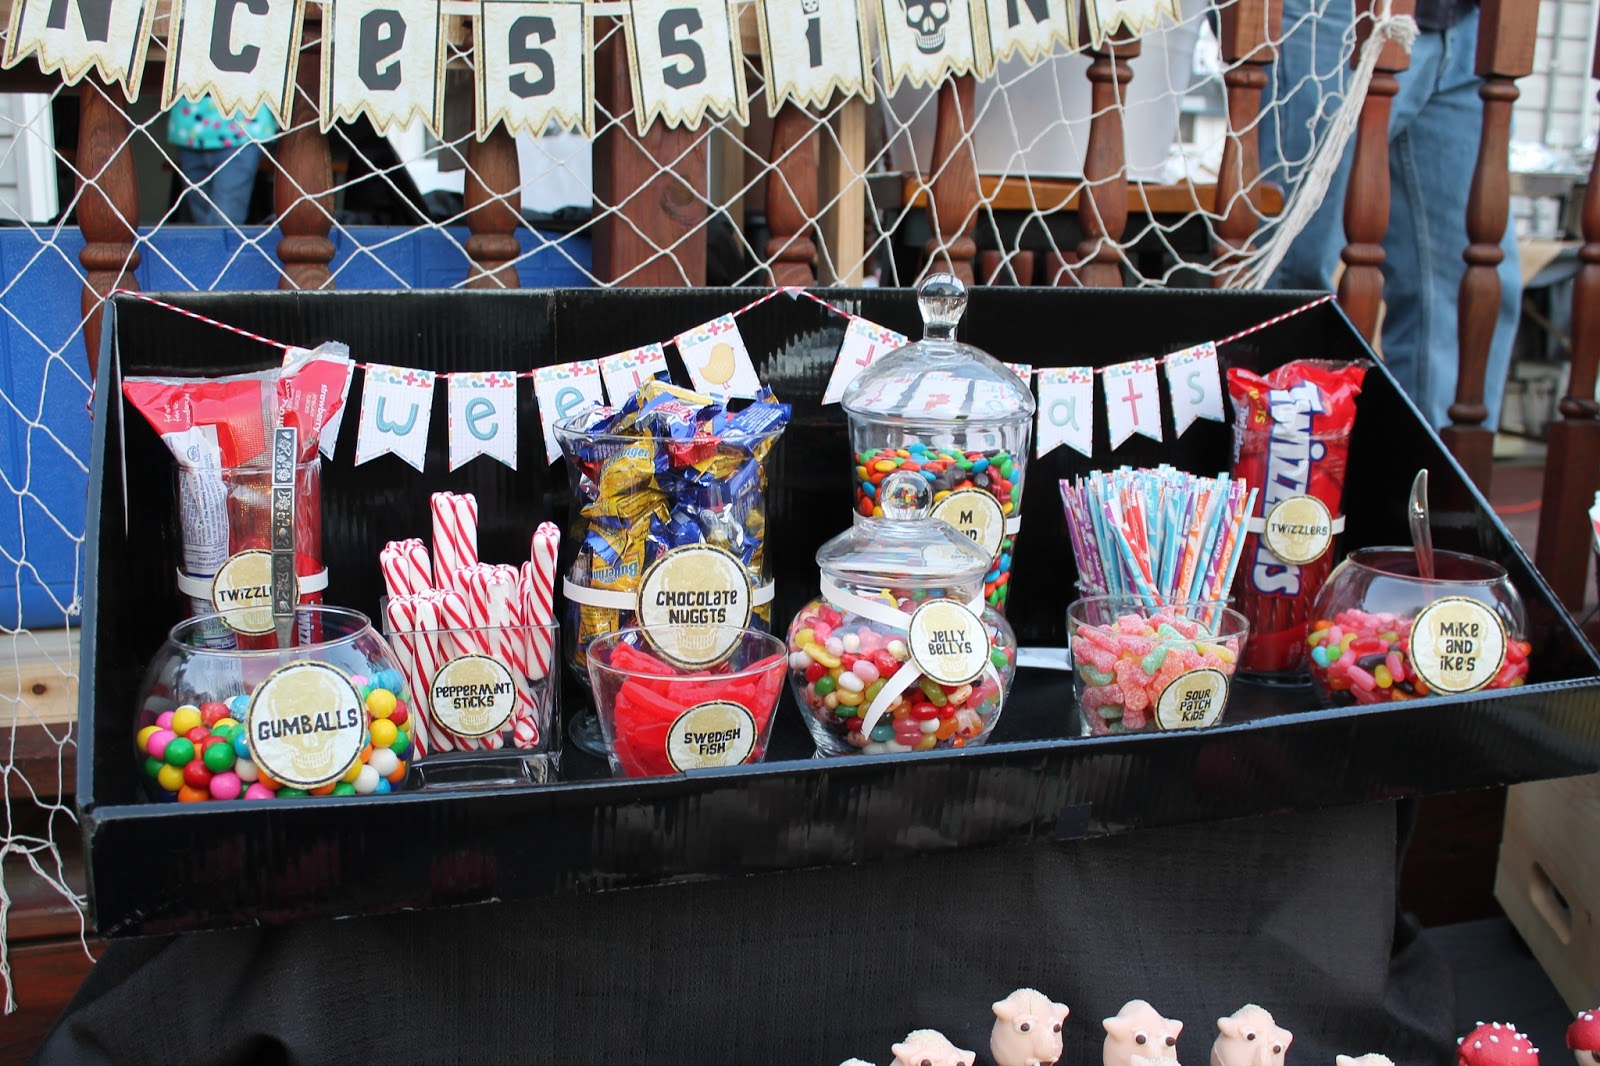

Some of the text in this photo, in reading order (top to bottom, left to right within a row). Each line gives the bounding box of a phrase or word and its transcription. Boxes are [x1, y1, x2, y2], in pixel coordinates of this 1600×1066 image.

[312, 383, 329, 434] strawberry
[959, 509, 973, 525] M
[668, 608, 727, 624] NUGGTS
[1184, 689, 1211, 700] SOUR
[257, 708, 359, 741] GUMBALLS
